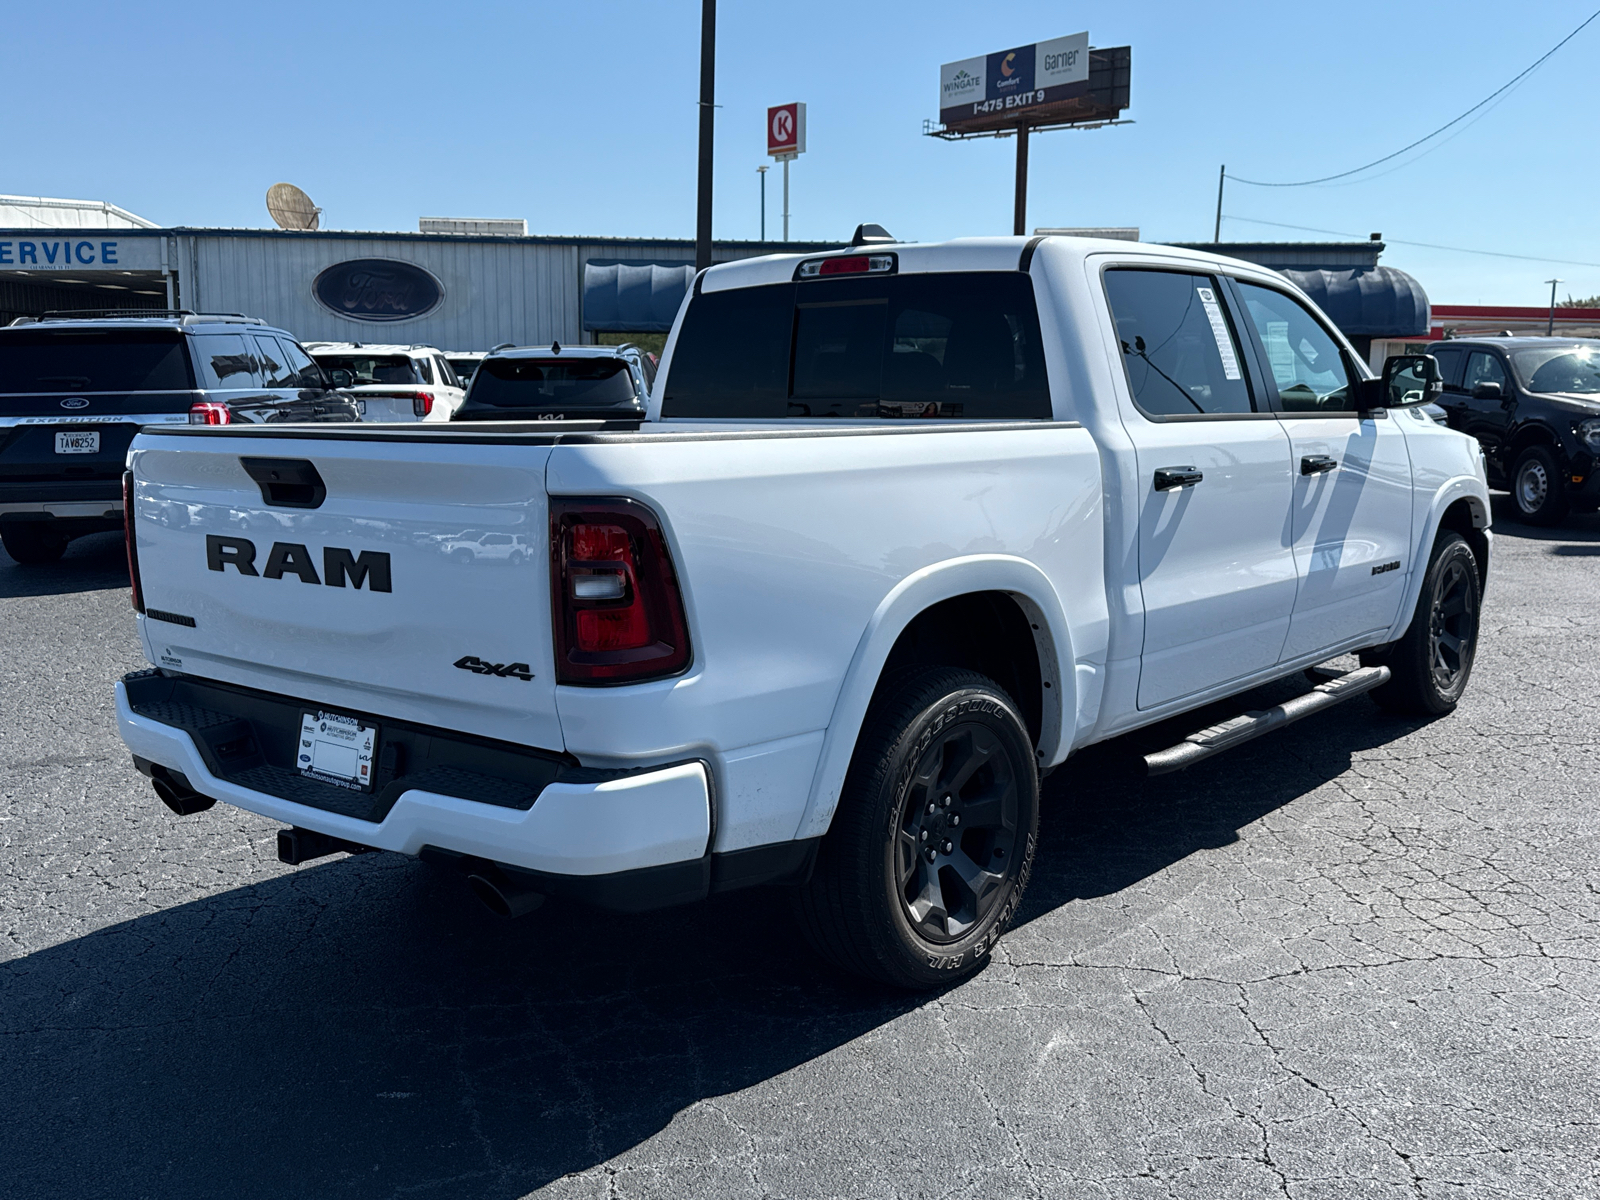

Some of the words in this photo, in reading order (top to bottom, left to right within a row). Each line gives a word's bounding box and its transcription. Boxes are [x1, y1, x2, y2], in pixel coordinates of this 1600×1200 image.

[1044, 49, 1079, 71] Garner
[943, 76, 981, 92] WINGATE
[996, 77, 1020, 88] Comfort
[973, 97, 1003, 115] I-475
[1005, 91, 1035, 109] EXIT
[1036, 89, 1045, 102] 9
[776, 113, 791, 139] K
[0, 241, 118, 264] ERVICE
[342, 269, 415, 310] Ford
[25, 416, 124, 424] EXPEDITION
[60, 437, 95, 448] TAV8252
[206, 534, 393, 593] RAM
[324, 712, 359, 726] HUTCHINSON
[326, 724, 358, 738] HUTCHINSON
